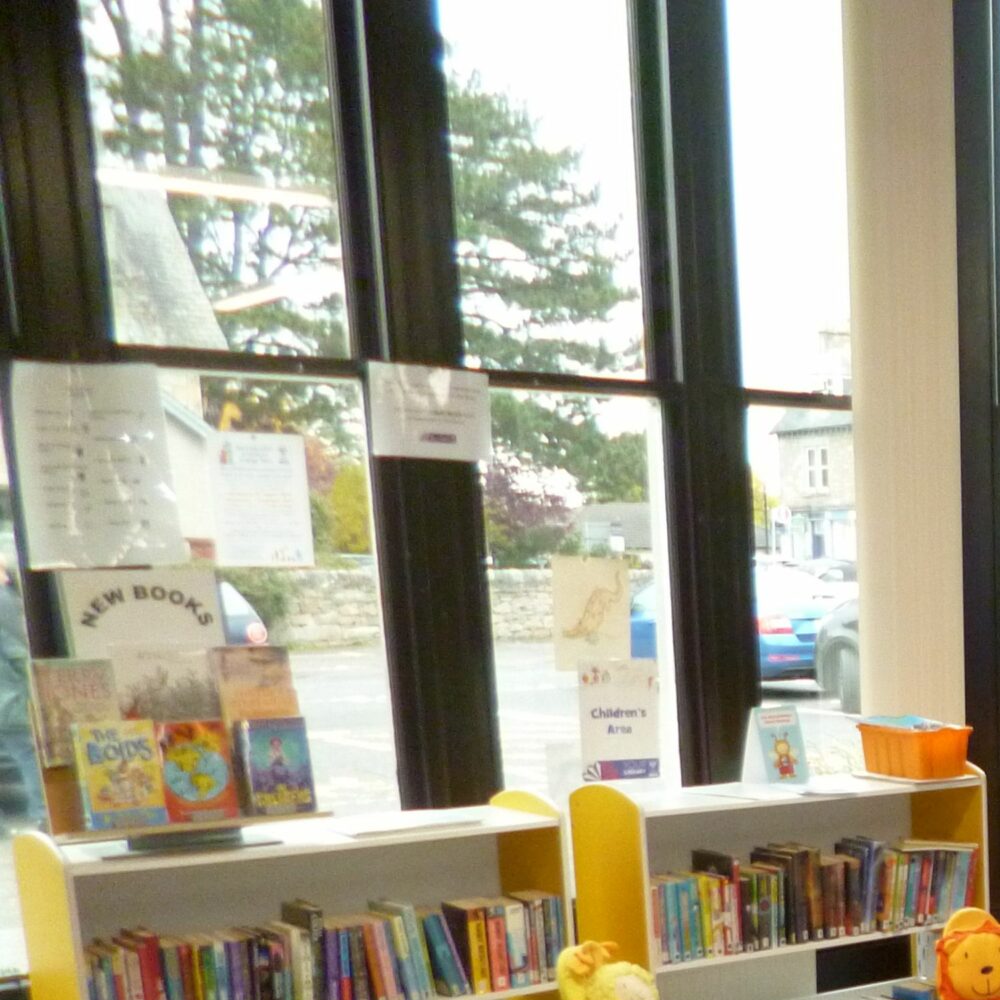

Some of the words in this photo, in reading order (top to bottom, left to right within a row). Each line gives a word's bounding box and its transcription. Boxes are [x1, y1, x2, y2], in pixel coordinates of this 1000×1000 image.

[81, 588, 126, 628] NEW
[133, 585, 213, 626] BOOKS
[590, 707, 647, 719] Children's
[607, 724, 632, 734] Area
